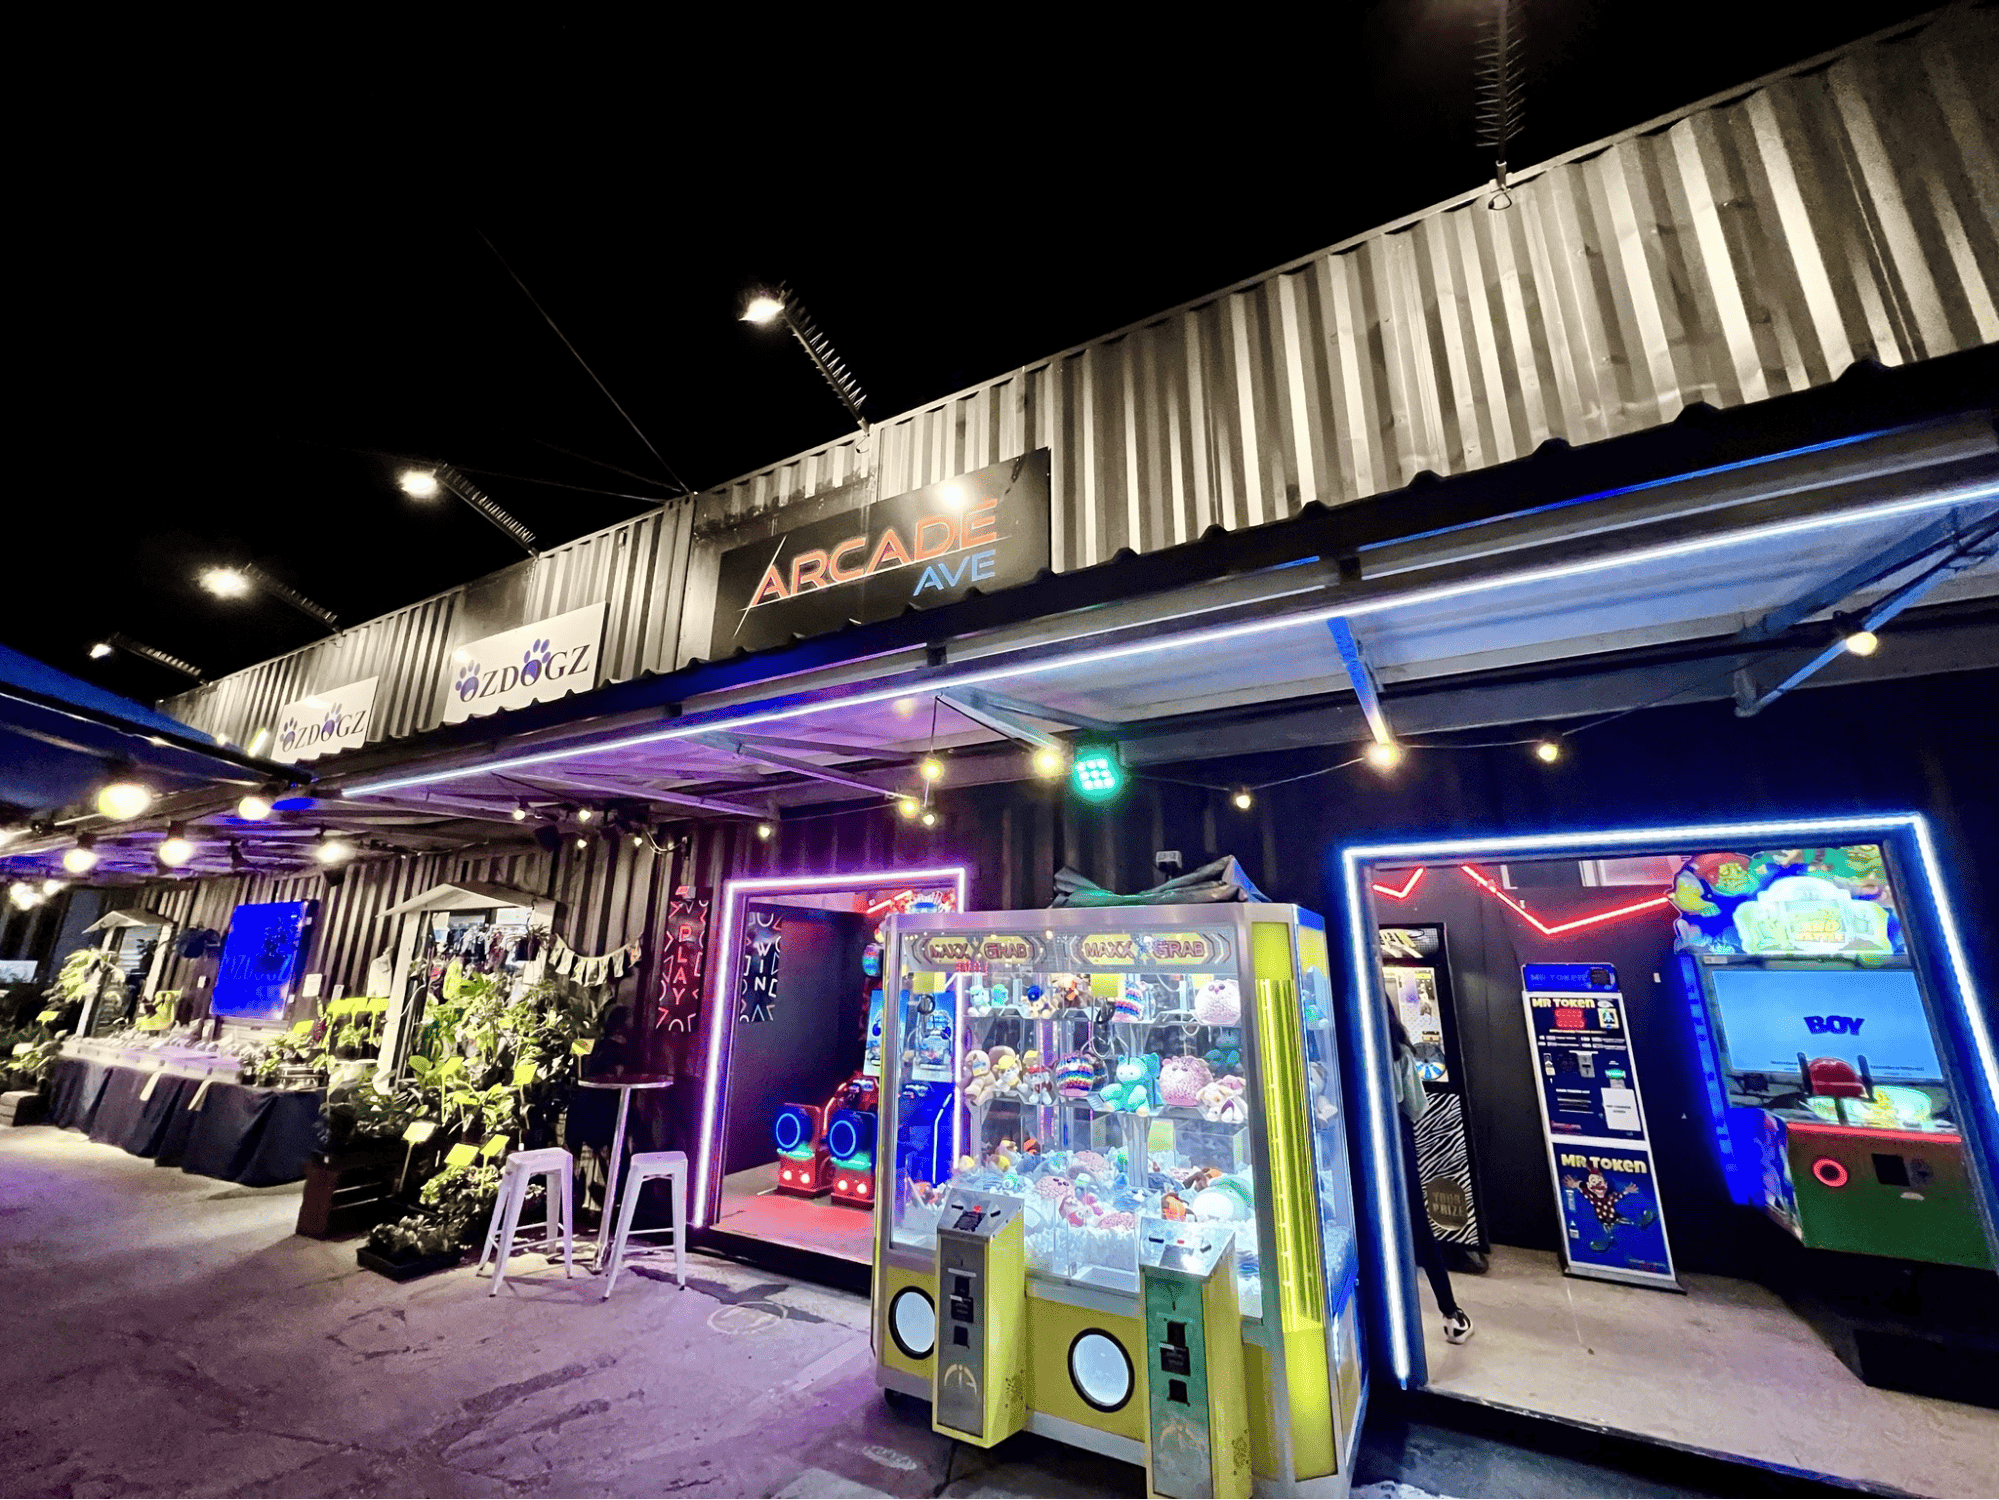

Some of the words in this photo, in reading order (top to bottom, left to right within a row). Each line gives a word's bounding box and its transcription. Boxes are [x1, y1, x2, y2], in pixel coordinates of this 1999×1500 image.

[752, 498, 998, 606] ARCADE
[912, 548, 996, 597] AVE
[459, 643, 591, 703] OZDOGZ
[281, 709, 367, 753] OZDOGZ
[672, 925, 693, 1006] PLAY
[929, 944, 969, 960] MAXX
[983, 944, 1027, 959] GRAB
[1084, 941, 1135, 959] MAXX
[1152, 939, 1206, 958] GRAB
[753, 941, 772, 992] WIN
[1531, 998, 1552, 1008] MR
[1803, 1014, 1865, 1037] BOY
[1560, 1153, 1587, 1168] MR
[1432, 1203, 1463, 1217] PRIZE
